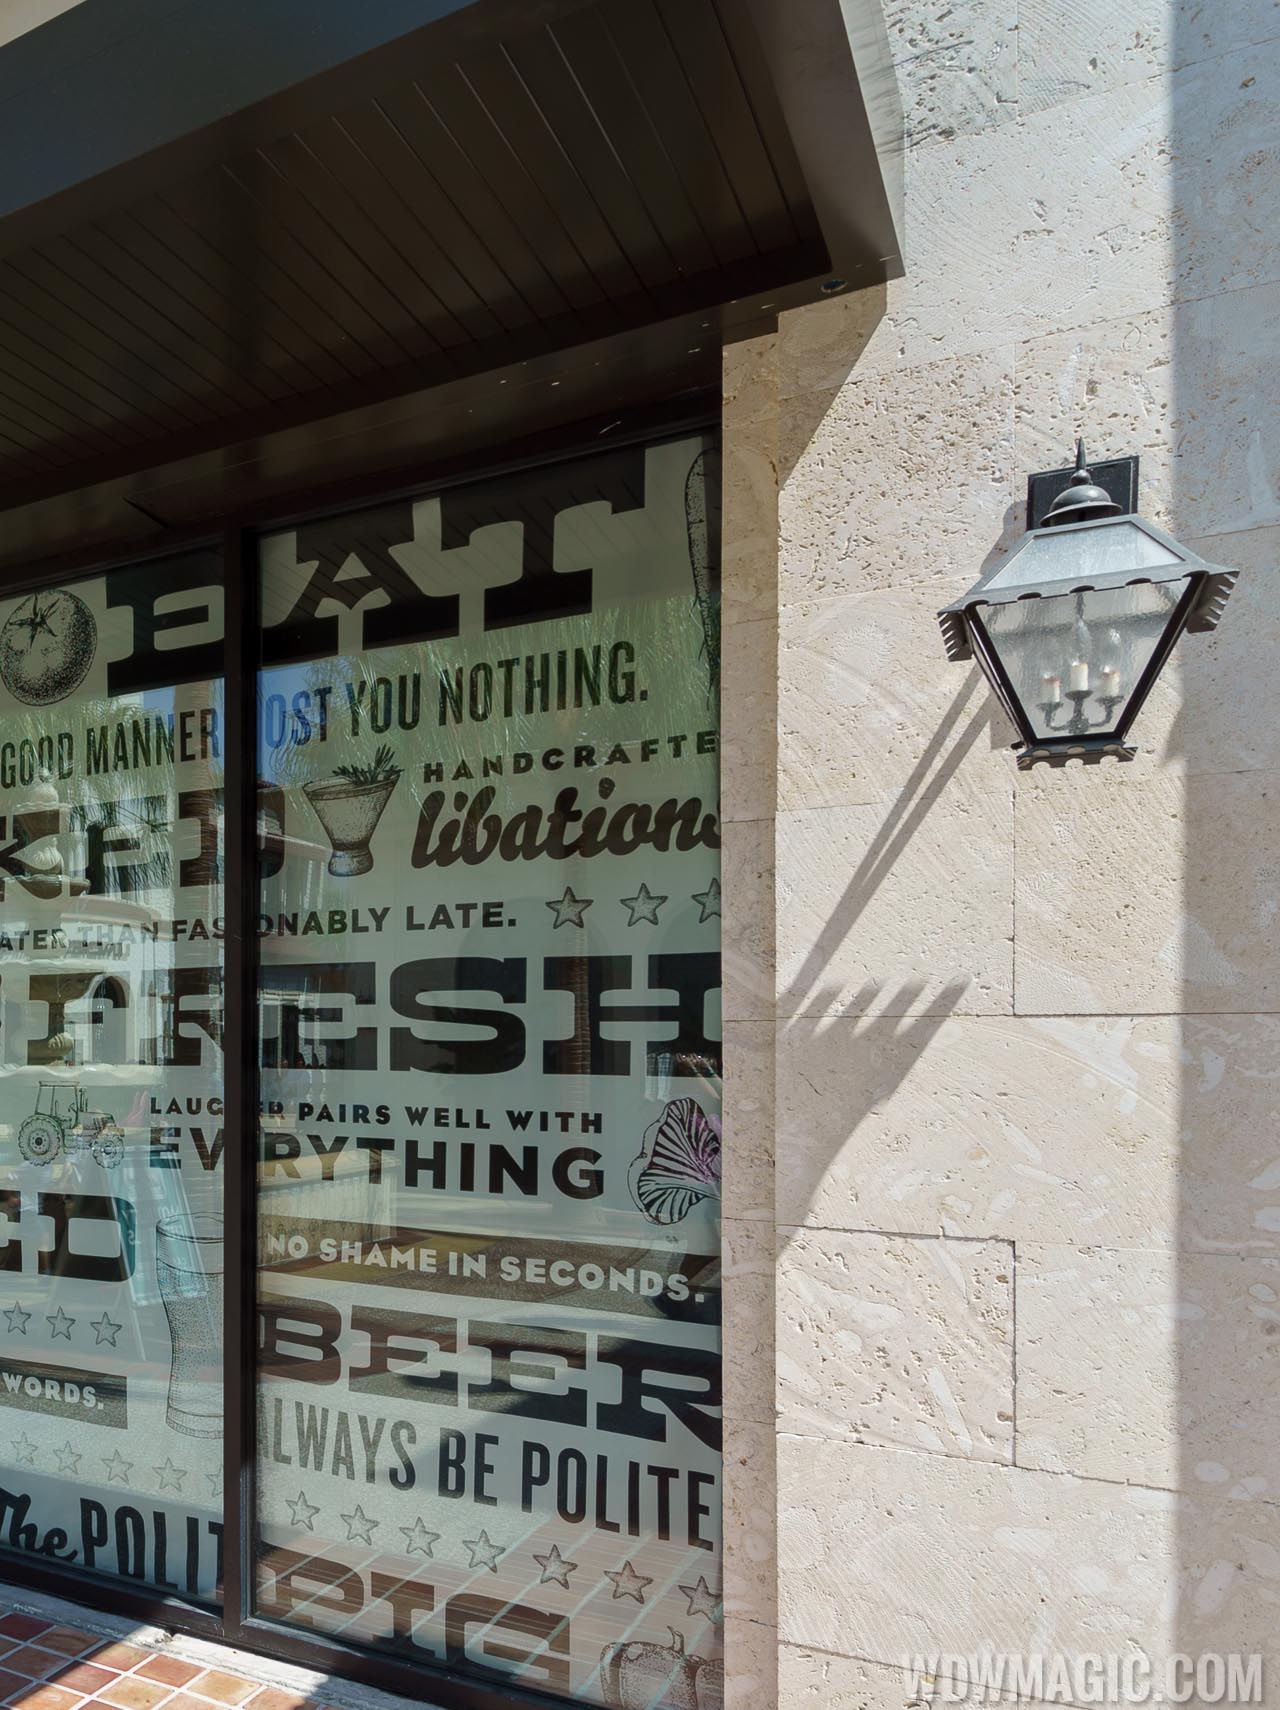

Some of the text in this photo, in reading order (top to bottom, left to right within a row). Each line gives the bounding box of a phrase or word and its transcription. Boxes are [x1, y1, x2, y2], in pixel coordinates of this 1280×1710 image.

[1, 641, 649, 789] GOOD MANNER OST YOU NOTHING.
[424, 730, 717, 783] HANDCRAFTE
[78, 920, 159, 947] THAN
[172, 907, 391, 942] FASONABLY
[406, 901, 517, 931] LATE.
[27, 952, 722, 1078] FRESH
[299, 1103, 391, 1125] PAIRS
[406, 1106, 490, 1129] WELL
[506, 1110, 603, 1134] WITH
[150, 1127, 605, 1200] EVRYTHING
[268, 1233, 705, 1303] NO SHAME IN SECONDS.
[1, 1371, 105, 1411] WORDS.
[257, 1291, 722, 1451] BEER
[438, 1427, 499, 1507] BE
[522, 1440, 715, 1552] POLITE
[80, 1497, 224, 1598] POLIT
